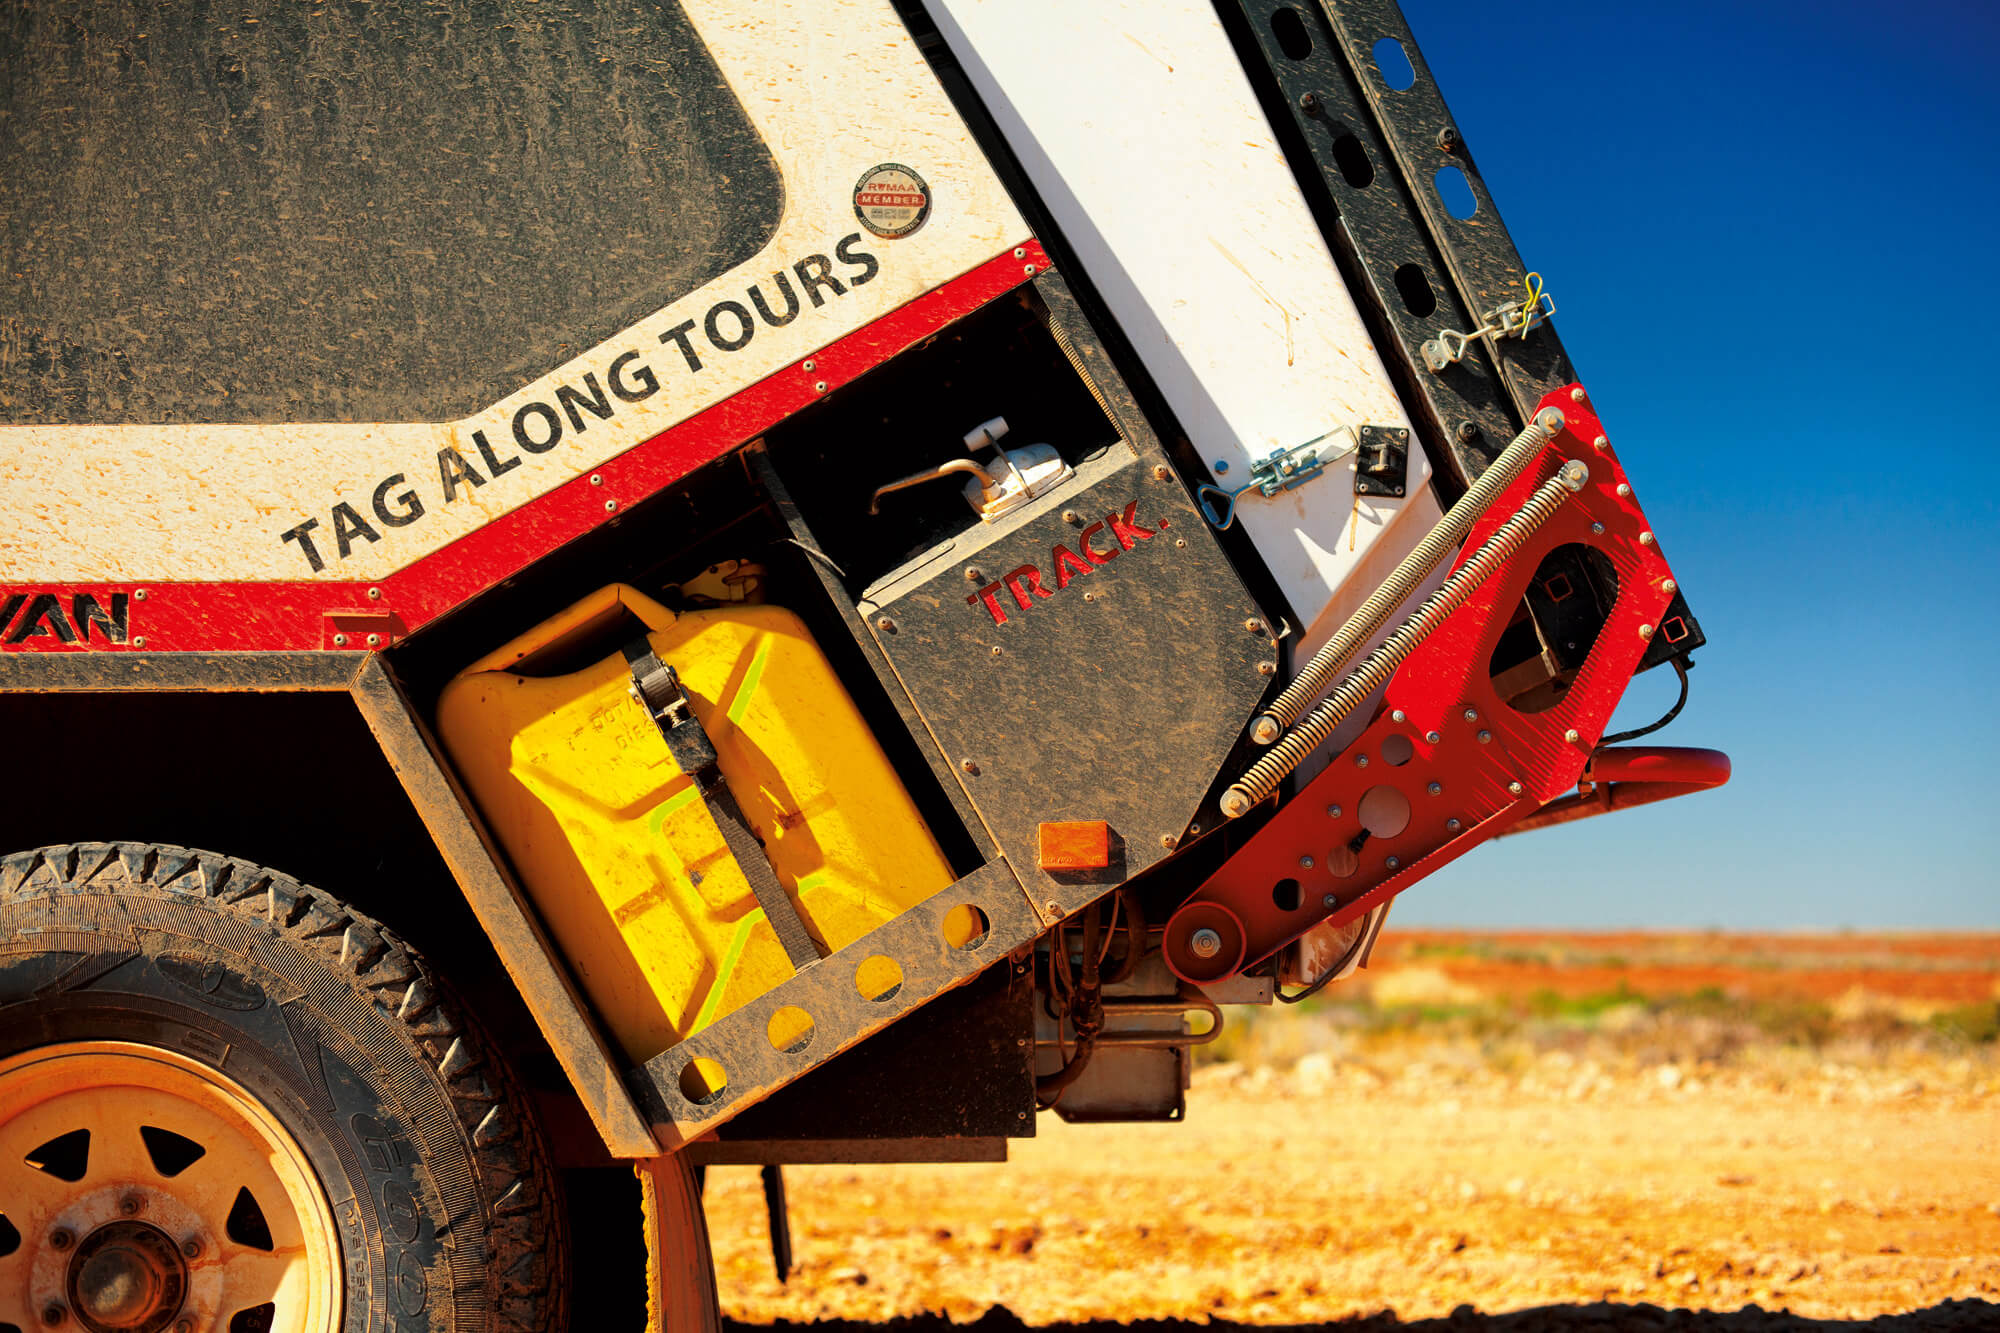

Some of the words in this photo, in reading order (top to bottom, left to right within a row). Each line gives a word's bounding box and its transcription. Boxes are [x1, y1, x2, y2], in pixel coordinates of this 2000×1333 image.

[862, 195, 920, 204] MEMBER
[281, 473, 425, 573] TAG
[437, 372, 660, 503] ALONG
[659, 233, 879, 373] TOURS
